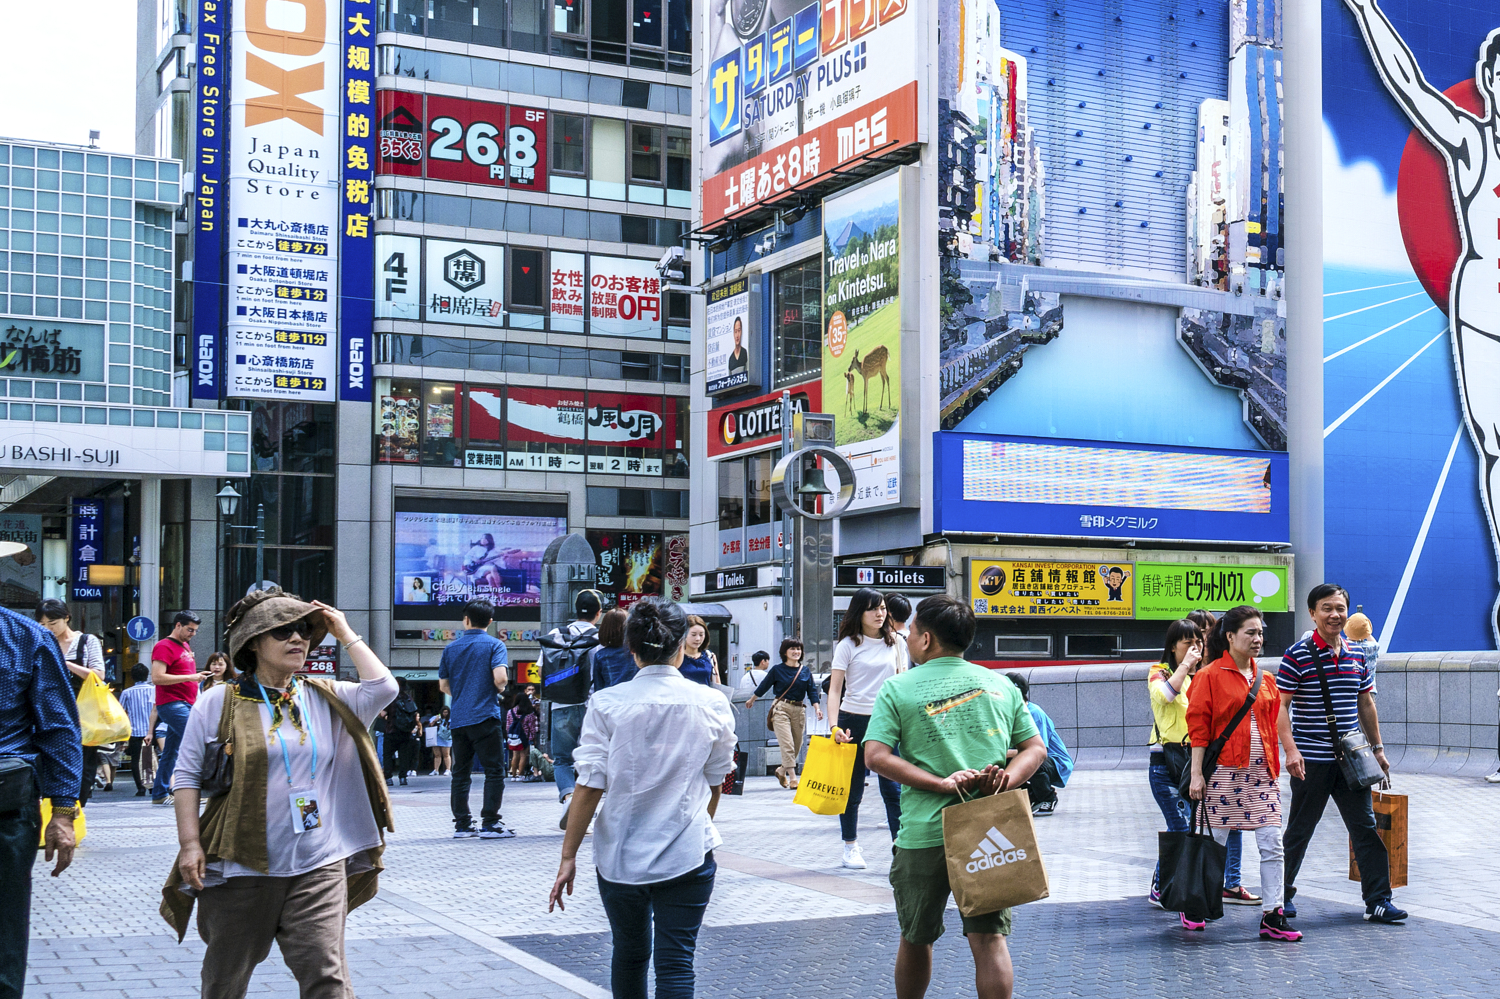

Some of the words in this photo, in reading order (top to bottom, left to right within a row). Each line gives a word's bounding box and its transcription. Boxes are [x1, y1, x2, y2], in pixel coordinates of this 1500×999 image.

[203, 34, 220, 79] Free
[744, 71, 812, 129] SATURDAY
[817, 48, 852, 92] PLUS
[203, 85, 219, 137] Store
[525, 110, 545, 123] 5F
[248, 136, 320, 160] Japan
[380, 138, 423, 160] うちくる
[429, 115, 539, 167] 268
[202, 147, 219, 164] in
[248, 158, 320, 182] Quality
[723, 137, 820, 215] 土曜あさ8時
[247, 179, 320, 200] Store
[198, 174, 218, 232] Japan
[251, 217, 329, 236] 大丸心斎橋店
[236, 239, 275, 250] ここから
[278, 240, 326, 255] 徒歩7分
[828, 254, 860, 277] Travel
[861, 252, 869, 266] to
[869, 238, 896, 261] Nara
[250, 263, 329, 282] 大阪道頓堀店
[453, 259, 476, 283] 相席
[551, 268, 661, 295] 女性のお客様
[828, 292, 837, 306] on
[838, 273, 887, 303] Kintetsu.
[236, 286, 274, 297] ここから
[278, 287, 326, 301] 徒歩1分
[430, 293, 493, 319] 相席屋
[551, 286, 618, 307] 飲み放題
[618, 294, 661, 322] 0円
[551, 303, 618, 319] 時間無制限
[249, 305, 328, 323] 大阪日本橋店
[6, 324, 62, 346] なんば
[236, 331, 274, 342] ここから
[276, 331, 326, 345] 徒歩11分
[832, 328, 843, 344] 35
[248, 354, 315, 370] 心斎橋筋店
[235, 376, 273, 387] ここから
[276, 376, 324, 389] 徒歩1分
[588, 403, 656, 441] 風月
[467, 452, 502, 467] 営業時間
[509, 459, 524, 467] AM
[646, 464, 660, 473] まで
[887, 476, 897, 490] 近鉄
[1079, 513, 1158, 530] 雪印メグミルク
[725, 572, 745, 587] Toilets
[877, 567, 925, 584] Toilets
[1012, 569, 1096, 584] 店舗情報館
[73, 588, 102, 597] TOKIA
[432, 581, 463, 597] chay
[1012, 583, 1096, 591] 居抜き店舗総合プロデュース
[1142, 573, 1183, 597] 賃貸・売買
[1185, 570, 1246, 602] ピタットハウス
[991, 605, 1026, 615] 株式会社
[1029, 605, 1082, 615] 関西インベスト
[311, 661, 334, 671] 268
[965, 848, 1028, 875] adidas
